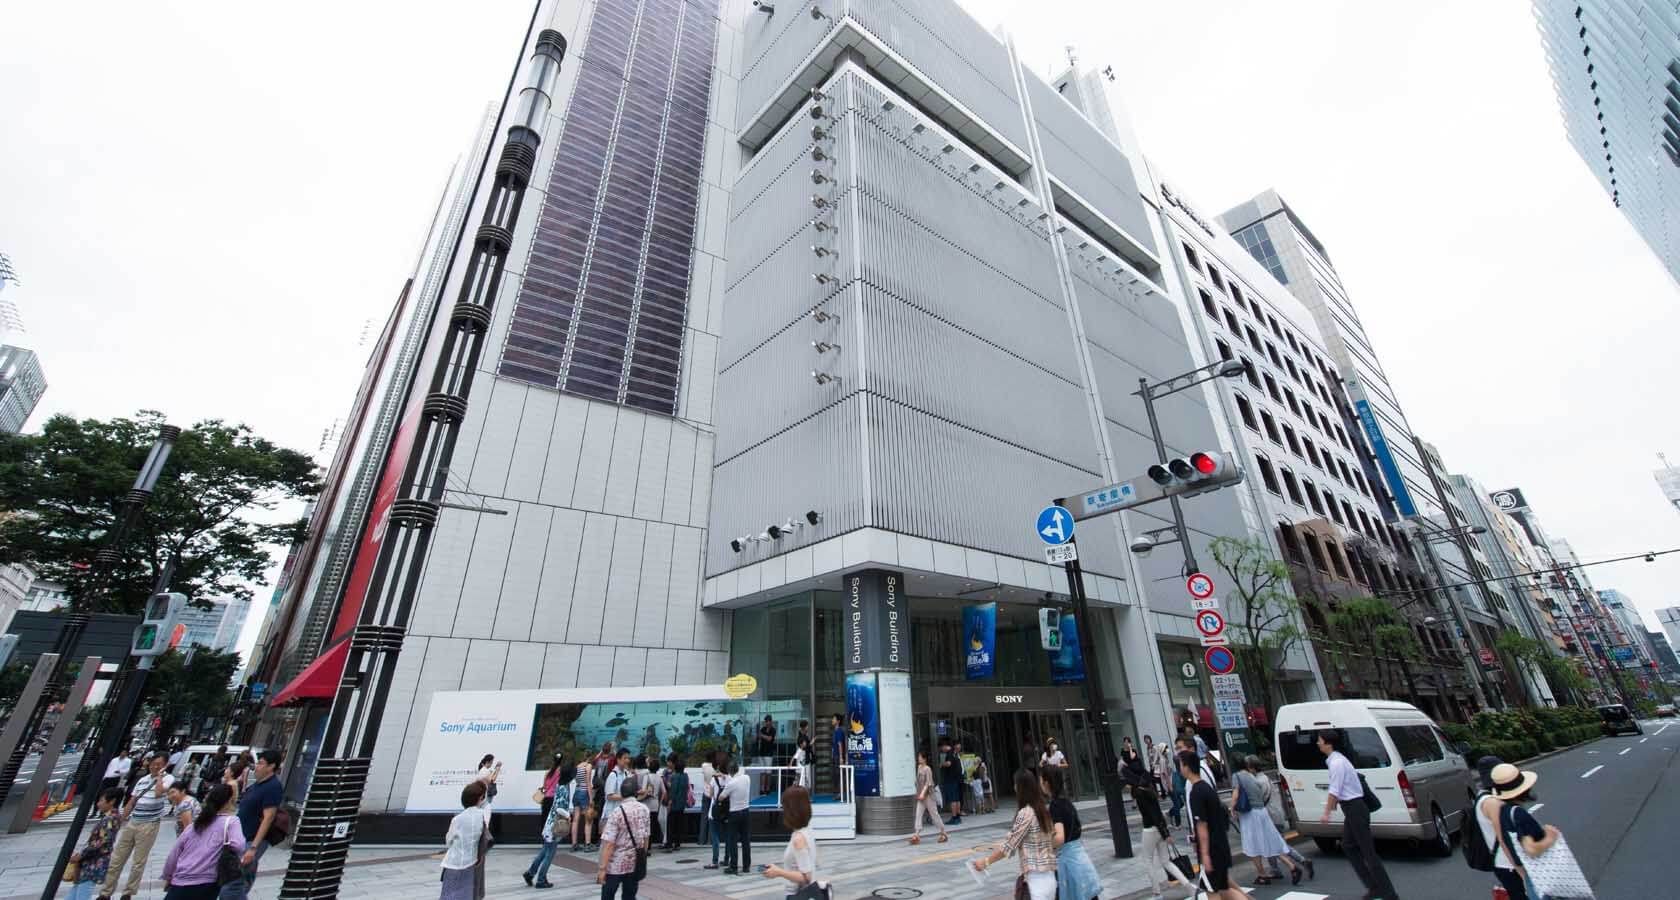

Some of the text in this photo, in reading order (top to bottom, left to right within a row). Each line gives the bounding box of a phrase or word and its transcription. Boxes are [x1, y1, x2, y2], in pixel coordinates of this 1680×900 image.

[850, 576, 862, 664] Sony Building
[886, 575, 900, 663] Sony Building
[995, 695, 1023, 704] SONY
[440, 721, 517, 735] Sony Aquarium
